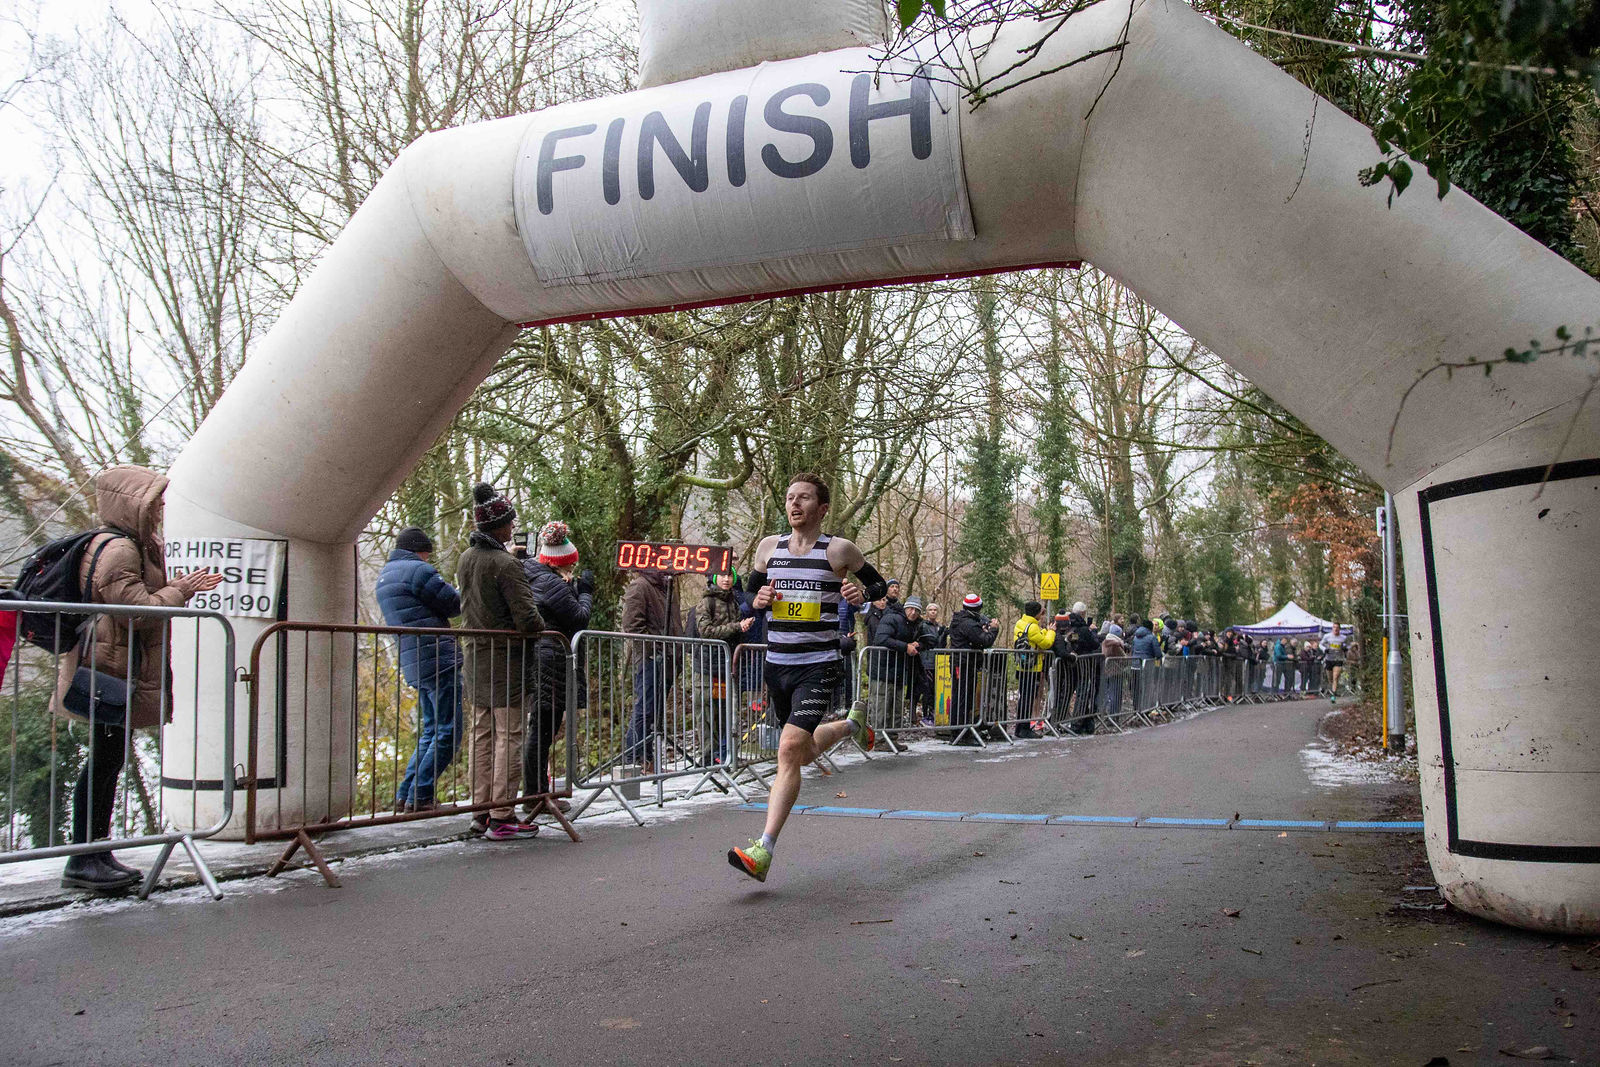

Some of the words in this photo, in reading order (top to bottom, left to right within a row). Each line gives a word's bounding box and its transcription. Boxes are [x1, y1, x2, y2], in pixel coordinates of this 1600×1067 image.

[536, 64, 932, 215] FINISH
[165, 542, 181, 558] OR
[187, 541, 243, 559] HIRE
[619, 543, 728, 572] 00:28:51
[184, 593, 270, 612] 58190
[788, 602, 802, 617] 82
